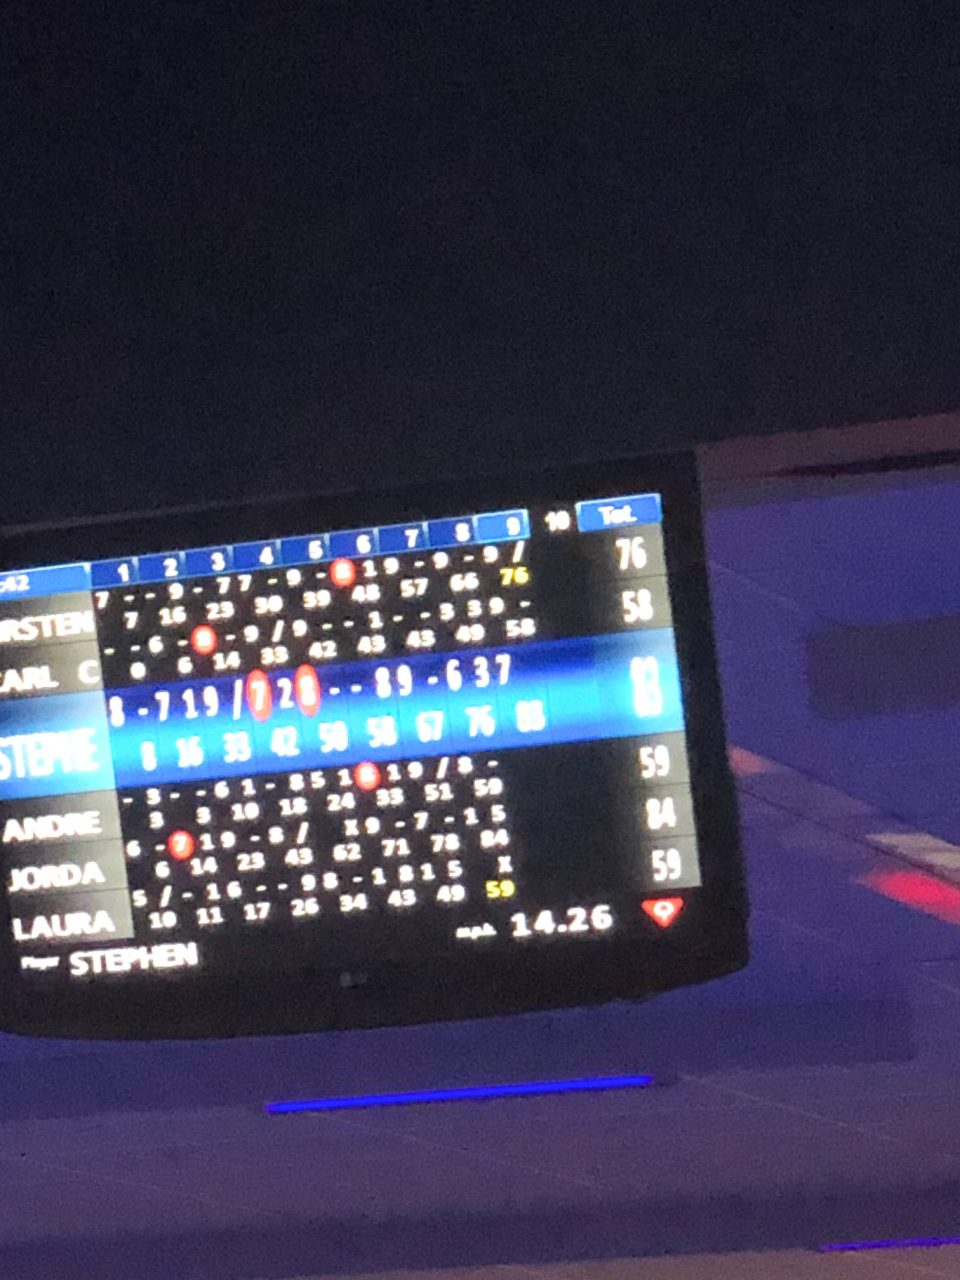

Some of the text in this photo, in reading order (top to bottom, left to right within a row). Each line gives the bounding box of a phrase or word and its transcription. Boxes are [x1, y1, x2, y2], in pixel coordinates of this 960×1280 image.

[117, 563, 130, 582] 1
[163, 558, 178, 577] 2
[211, 552, 225, 570] 3
[259, 546, 274, 565] 4
[308, 540, 323, 559] 5
[356, 534, 371, 554] 6
[405, 529, 419, 547] 7
[455, 523, 470, 542] 8
[506, 517, 521, 536] 9
[545, 511, 569, 530] 10
[598, 505, 638, 525] Tot.
[616, 537, 647, 570] 76
[124, 567, 529, 629] 7 16 23 30 39 48 57 66 76
[622, 589, 654, 623] 58
[130, 618, 536, 680] 0 6 14 33 42 43 43 49 58
[2, 745, 670, 843] ANDRE 59
[149, 778, 503, 830] 3 3 10 18 24 33 51 59
[8, 797, 677, 893] JORDA 84
[154, 828, 509, 878] 6 14 23 43 62 71 78 84
[12, 848, 681, 941] LAURA 59
[148, 879, 516, 929] 10 11 17 26 34 43 49 59
[510, 904, 614, 938] 14.26
[69, 942, 198, 977] STEPHEN
